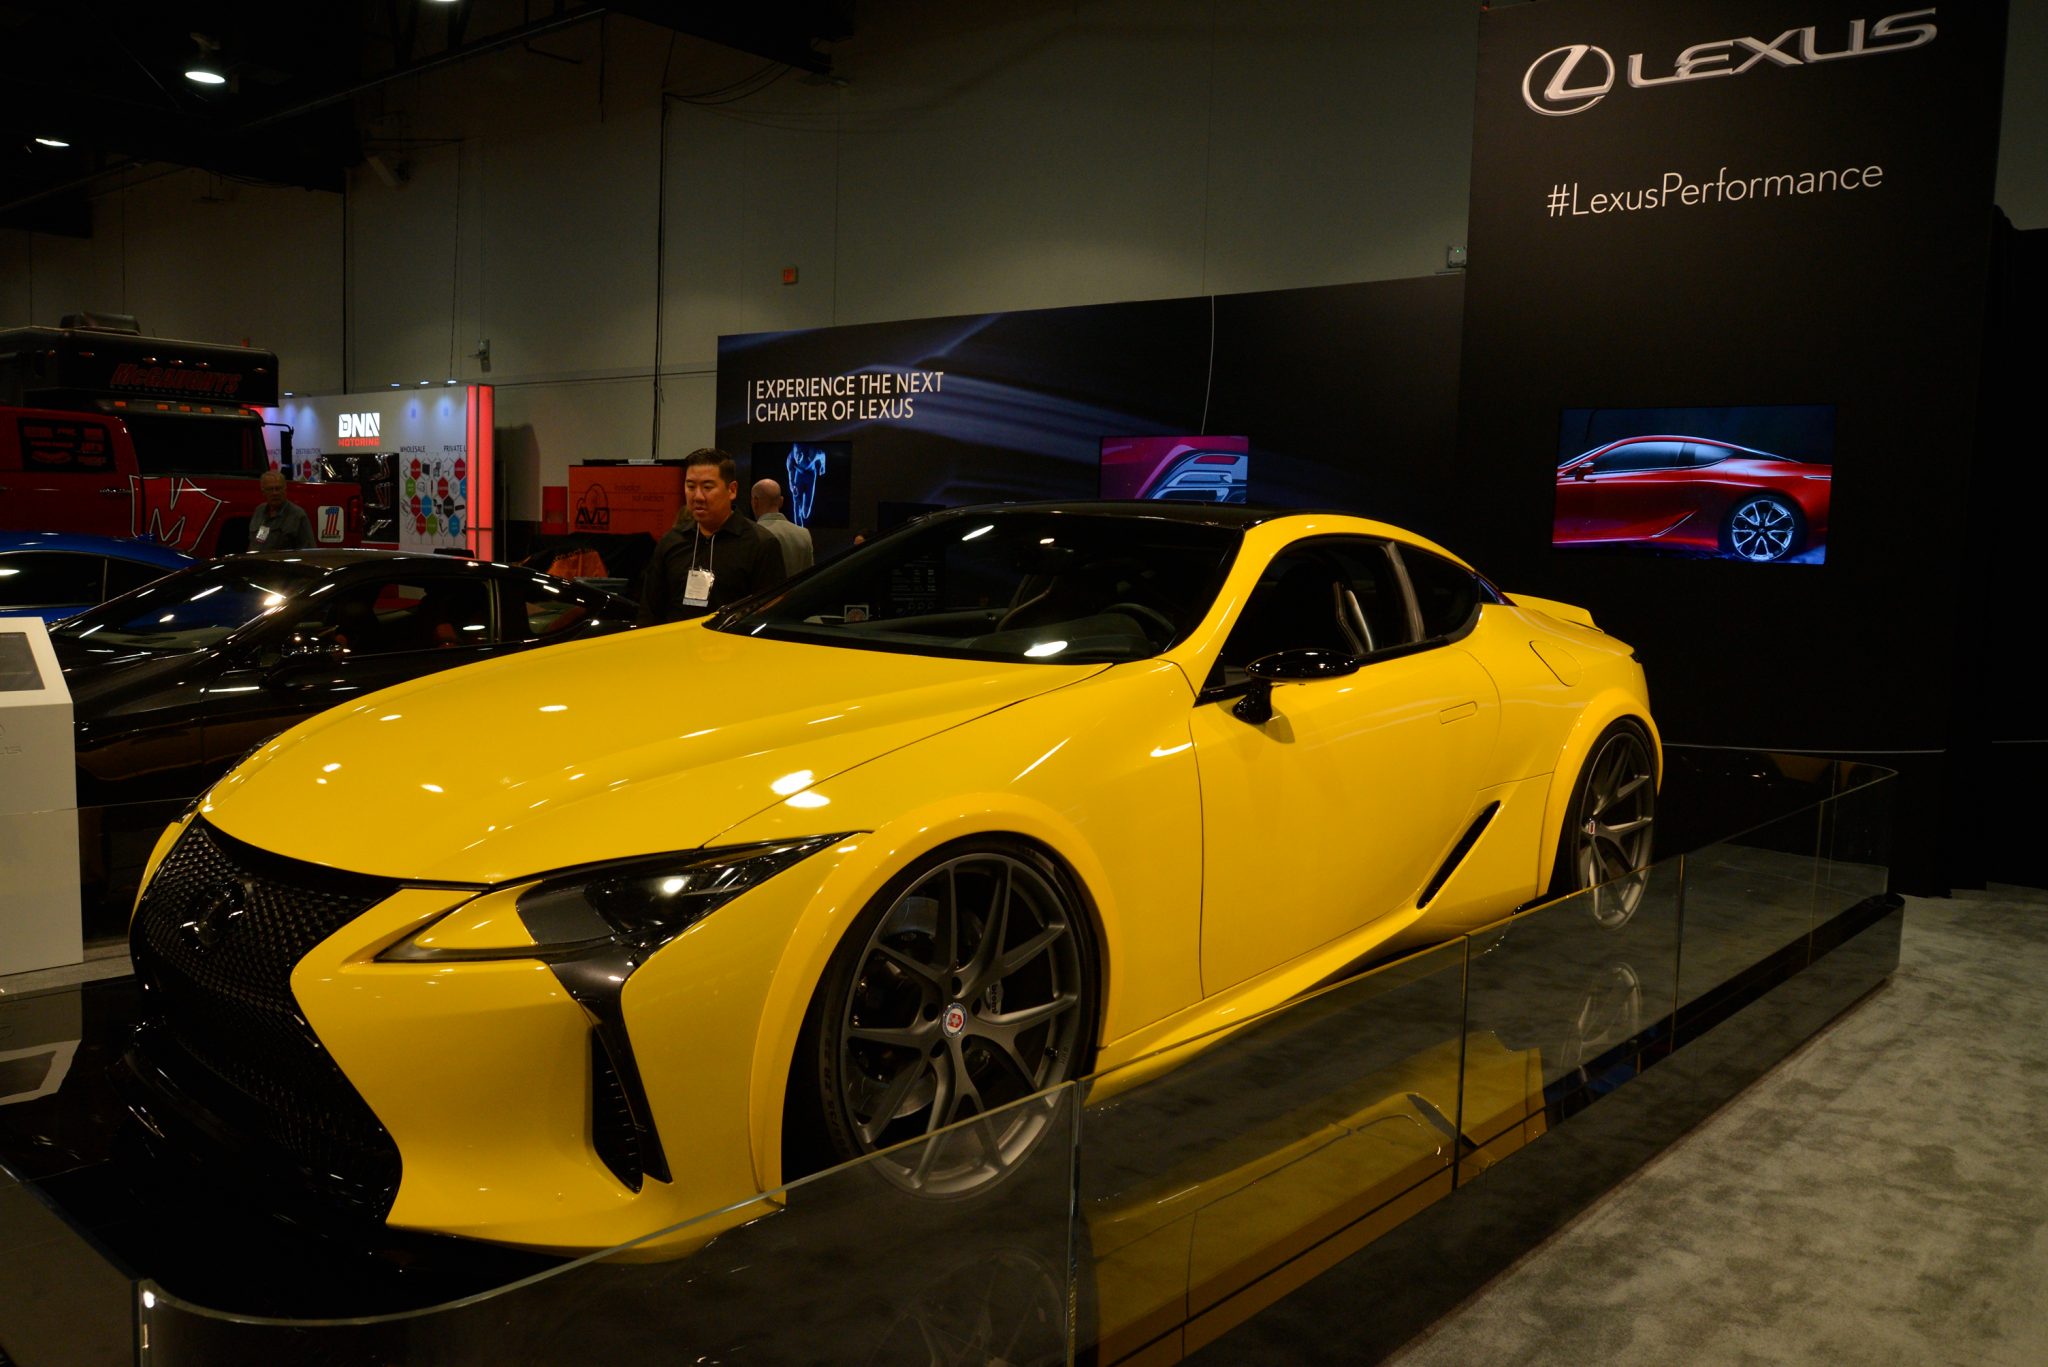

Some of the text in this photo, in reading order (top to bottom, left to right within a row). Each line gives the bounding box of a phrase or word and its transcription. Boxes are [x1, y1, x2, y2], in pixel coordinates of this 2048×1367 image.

[1627, 7, 1938, 88] LEXUS
[1547, 161, 1884, 218] #LexusPerformance
[755, 371, 945, 399] EXPERIENCE THE NEXT
[755, 397, 914, 423] CHAPTER OF LEXUS
[338, 412, 381, 438] DNA
[337, 437, 381, 448] MOTORING
[400, 445, 426, 453] WHOLESALE
